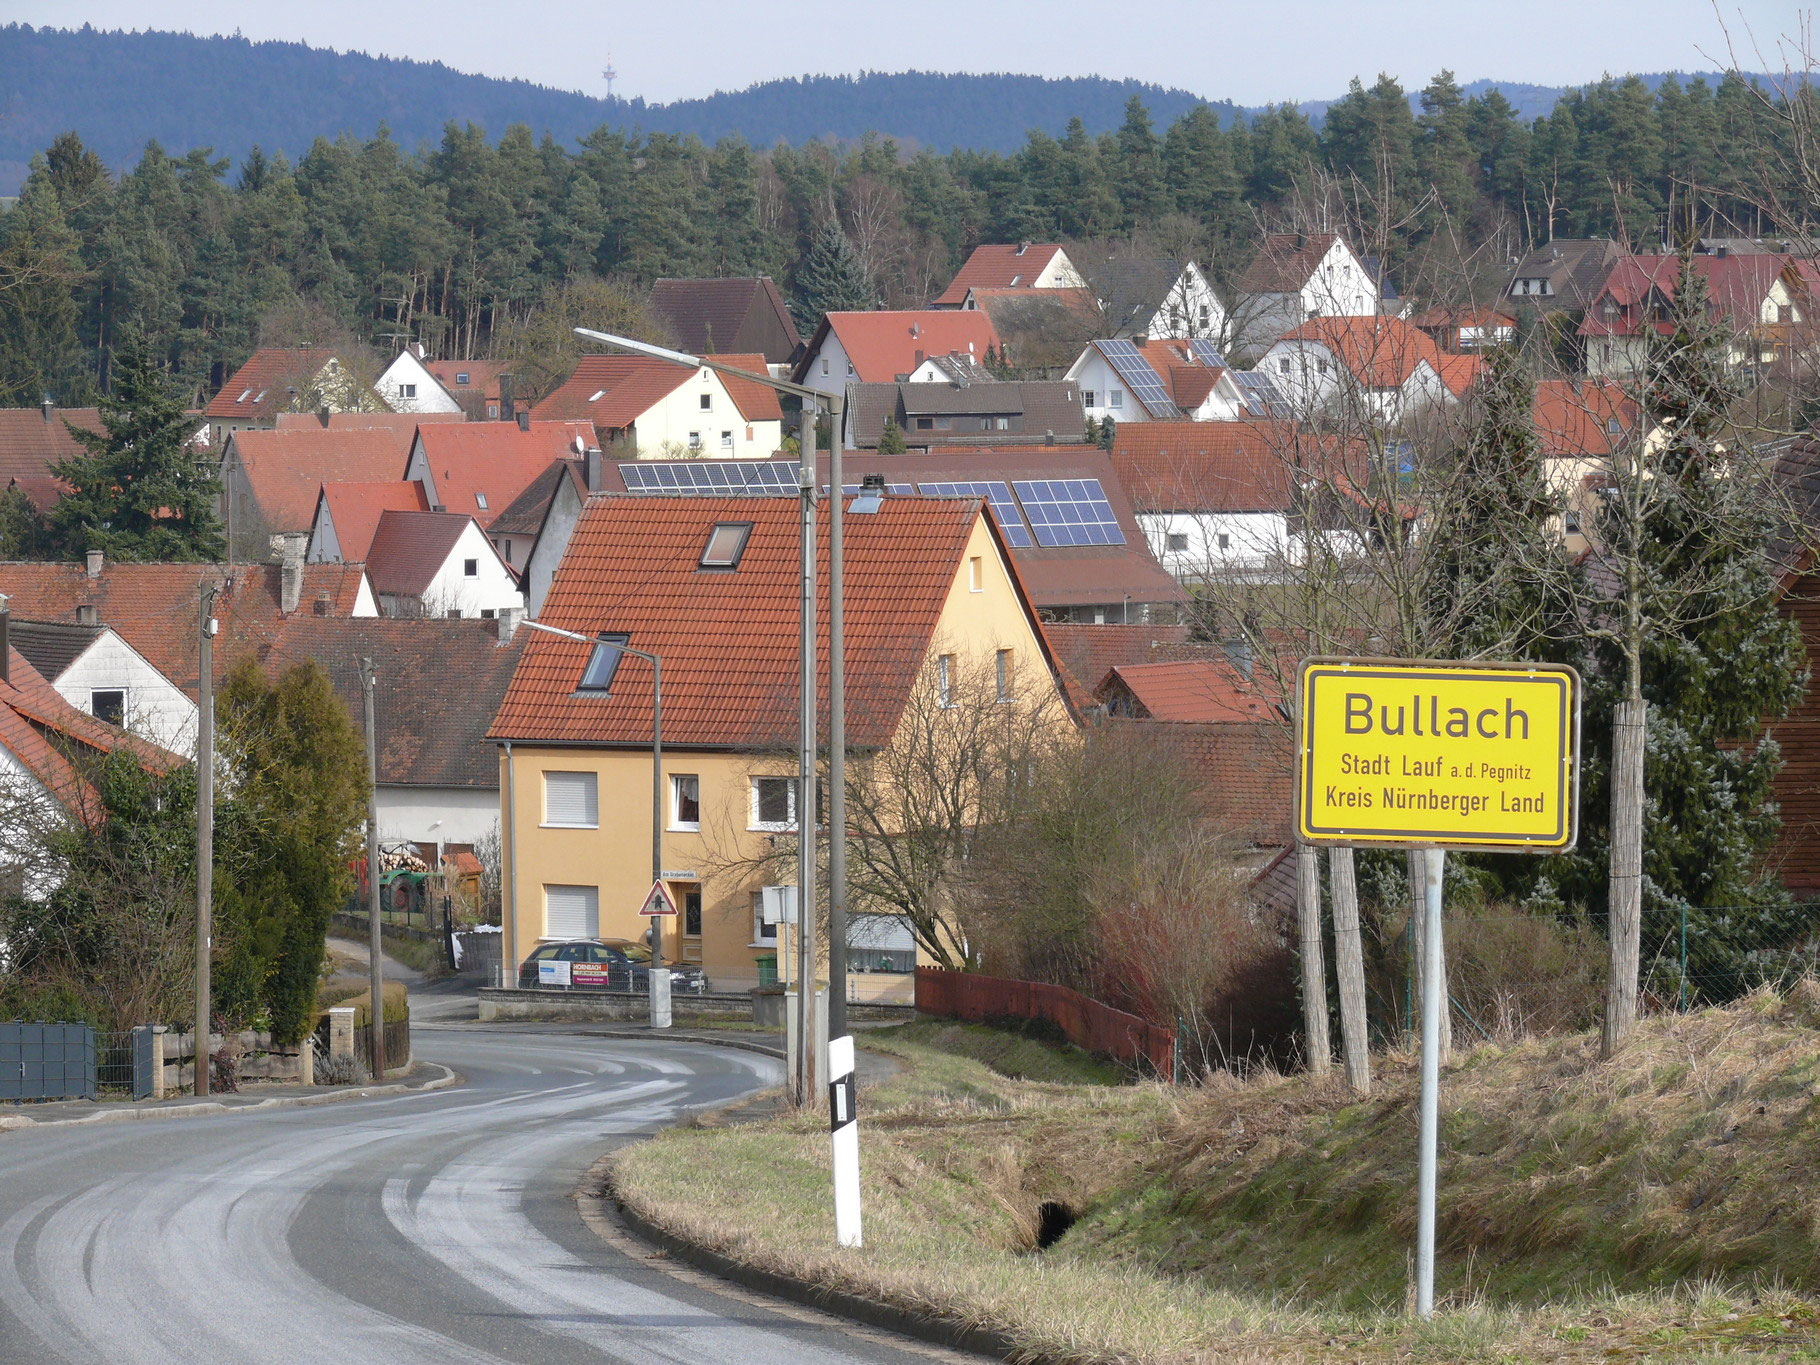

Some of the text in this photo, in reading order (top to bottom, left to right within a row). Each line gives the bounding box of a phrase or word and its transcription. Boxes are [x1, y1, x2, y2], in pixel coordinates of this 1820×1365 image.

[1344, 692, 1529, 740] Bullach
[1340, 752, 1391, 776] Stadt
[1402, 754, 1443, 777] Lauf
[1481, 762, 1531, 784] Pegnitz
[1326, 785, 1544, 817] Kreis Nürnberger Land
[573, 963, 602, 971] HORNBACH
